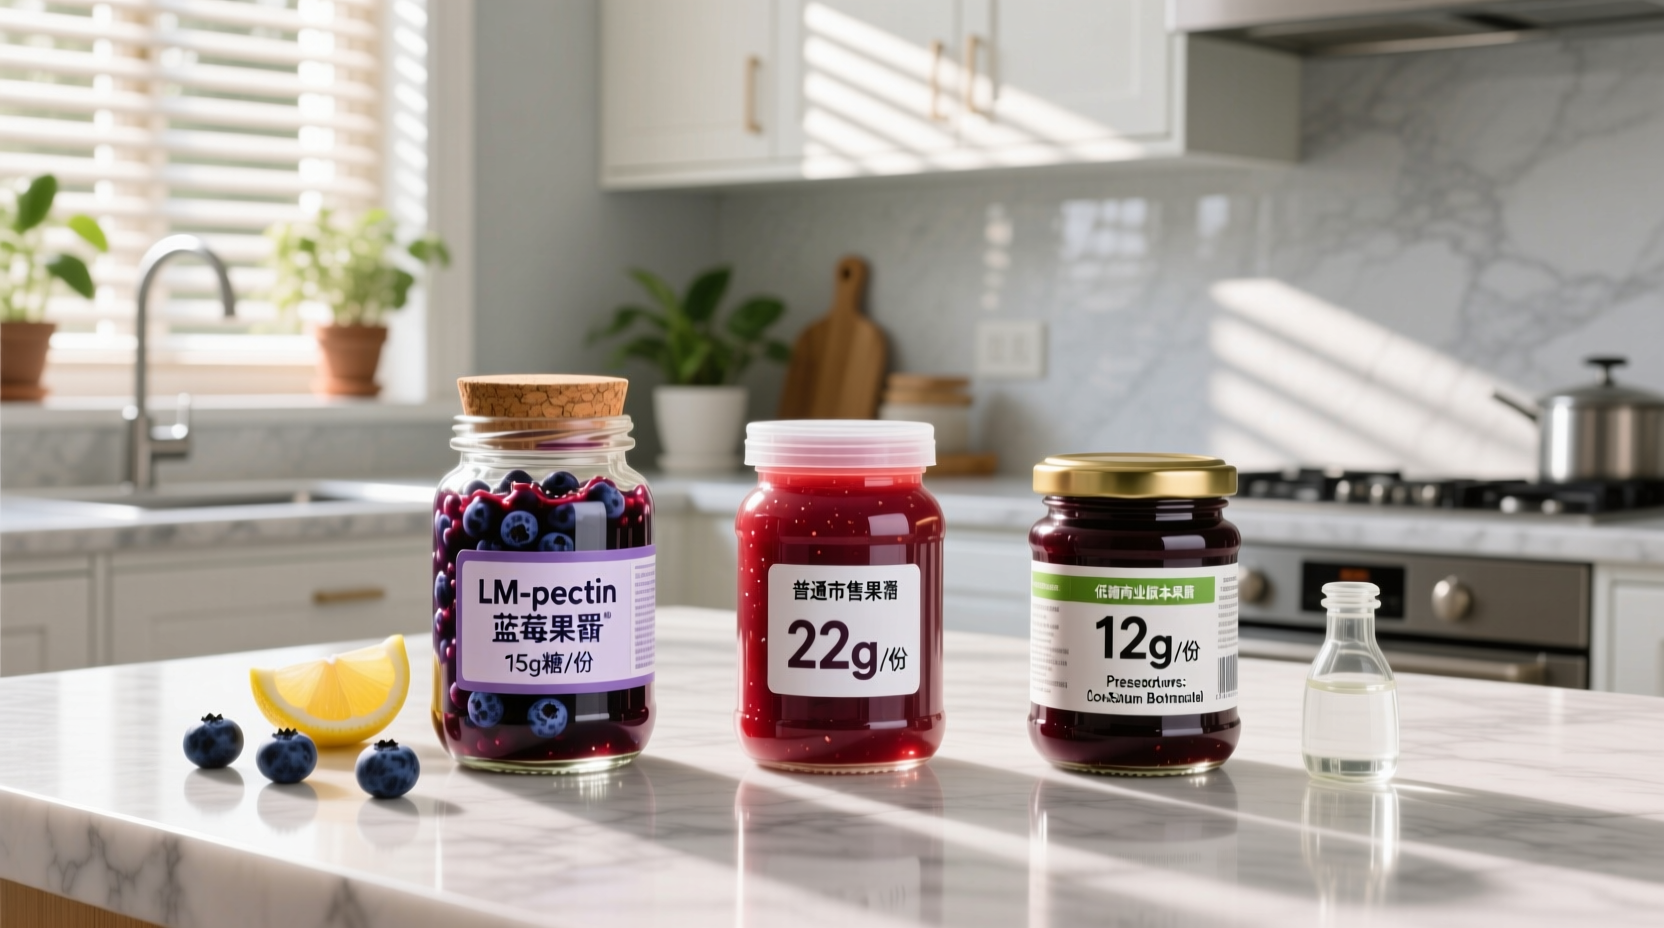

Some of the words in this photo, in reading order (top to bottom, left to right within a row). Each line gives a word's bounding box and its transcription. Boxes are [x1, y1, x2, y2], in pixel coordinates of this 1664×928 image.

[478, 577, 617, 612] LM-pectin
[504, 651, 594, 677] 15g糖/份
[787, 618, 909, 681] 22g/份
[1095, 615, 1201, 670] 12g/份
